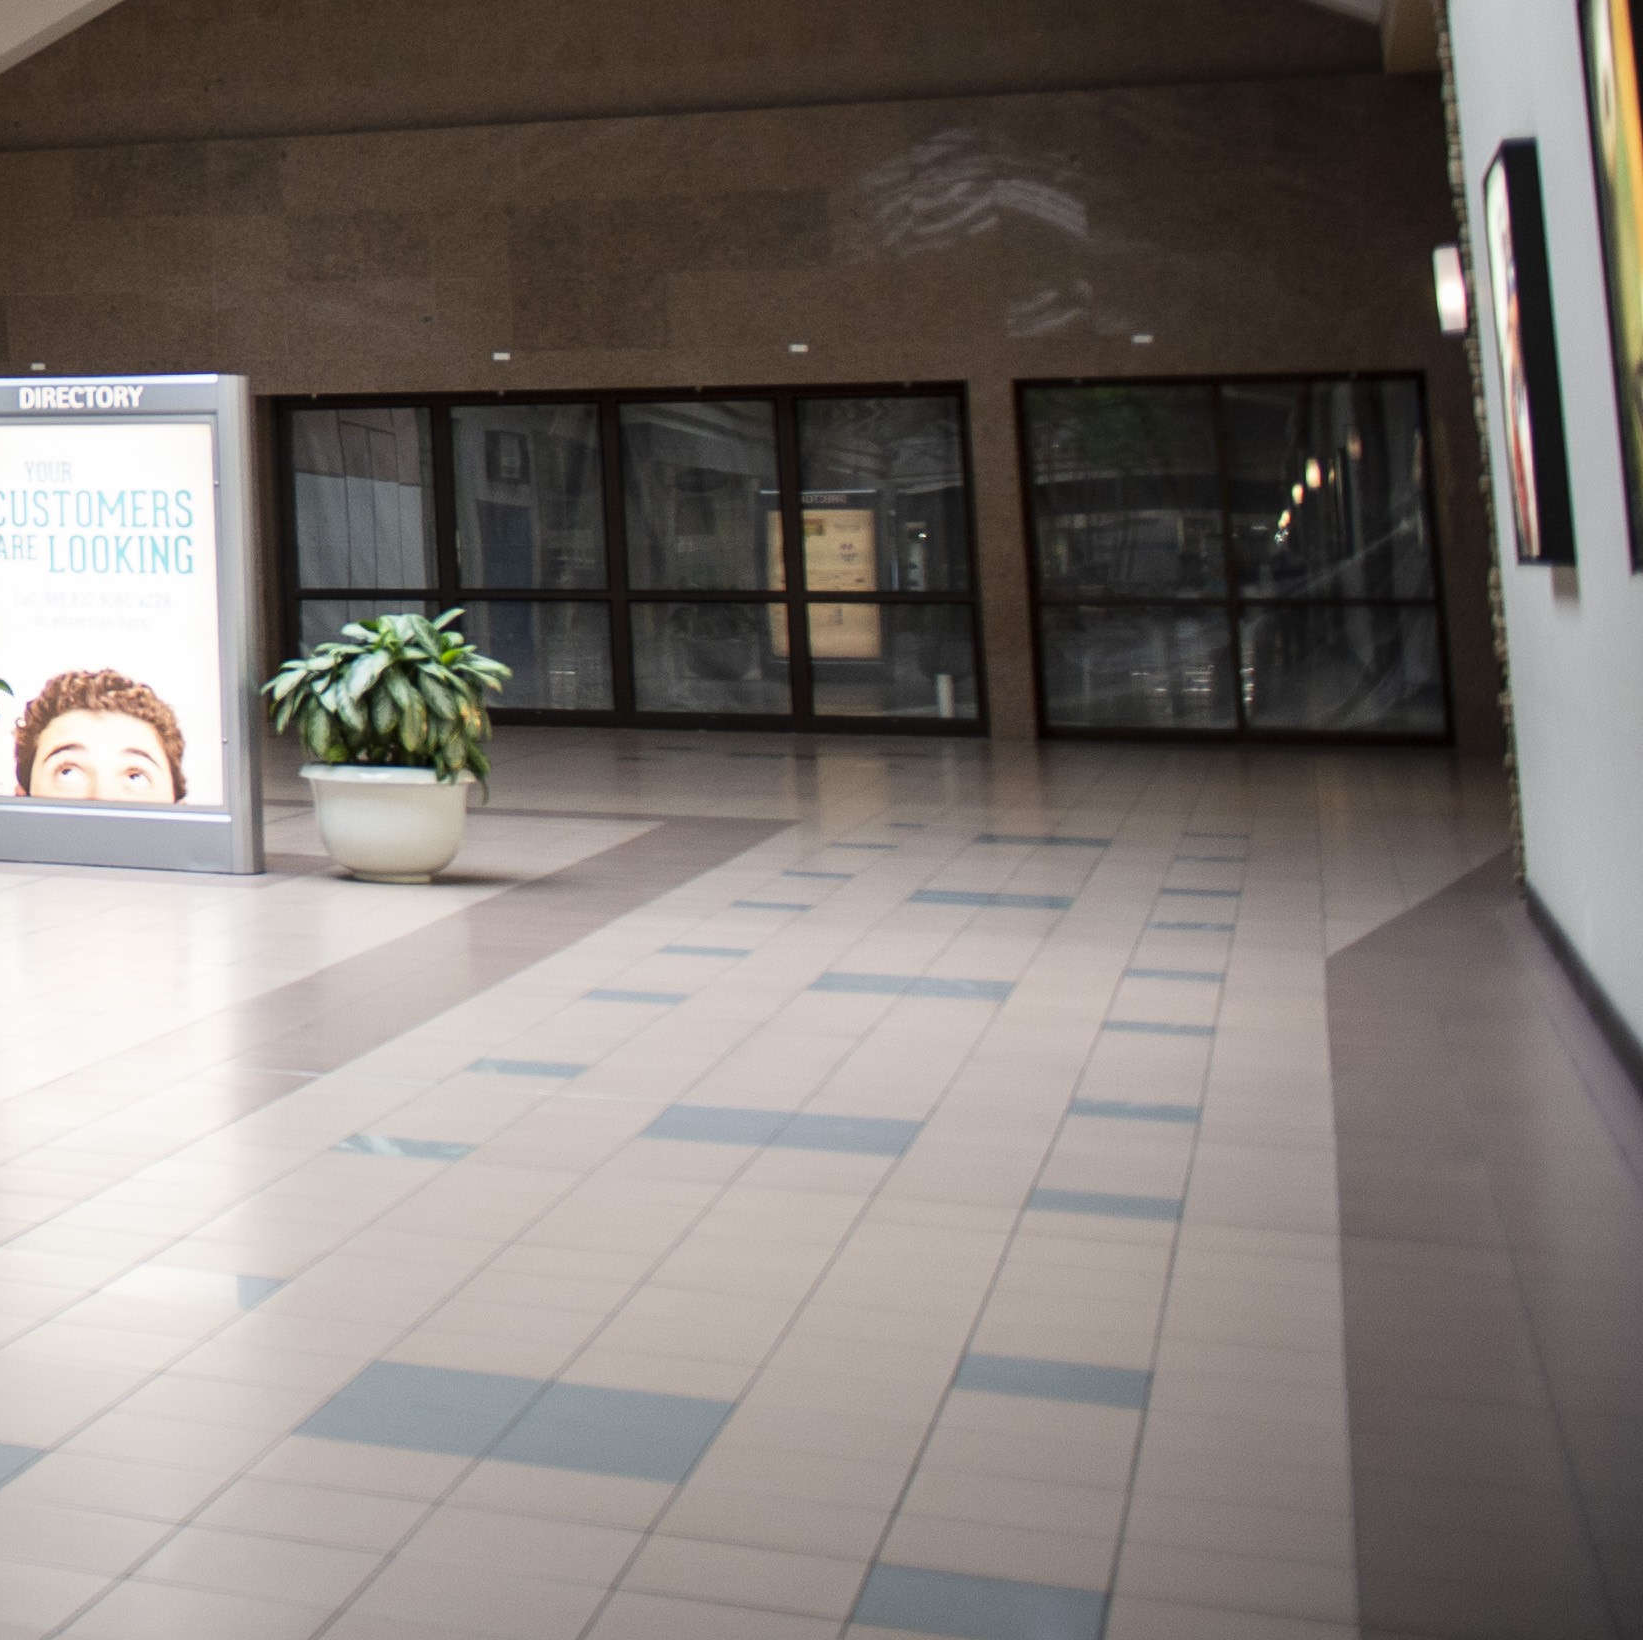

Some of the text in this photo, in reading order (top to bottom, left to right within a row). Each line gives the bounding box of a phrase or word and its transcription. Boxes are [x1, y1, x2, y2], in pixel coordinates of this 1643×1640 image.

[19, 385, 143, 409] DIRECTORY
[24, 461, 72, 482] YOUR
[48, 534, 194, 575] LOOKING
